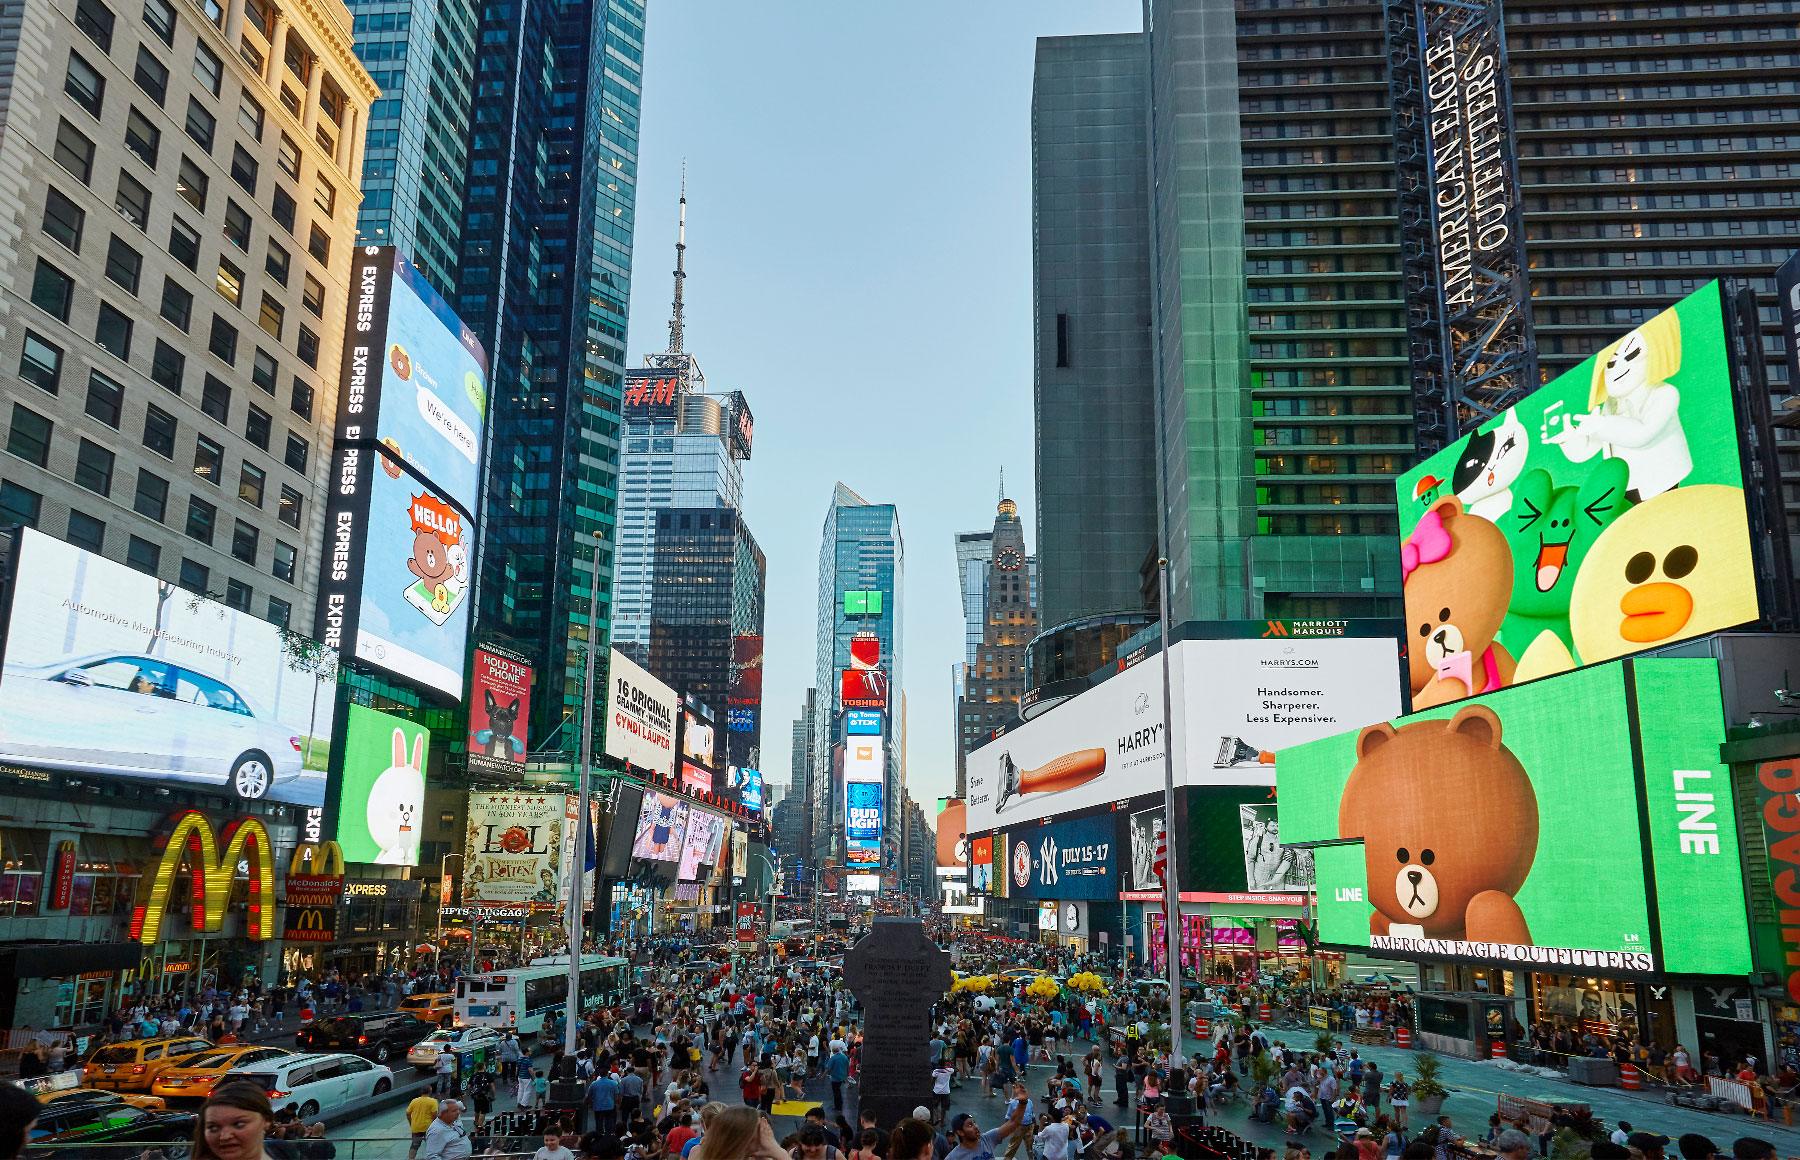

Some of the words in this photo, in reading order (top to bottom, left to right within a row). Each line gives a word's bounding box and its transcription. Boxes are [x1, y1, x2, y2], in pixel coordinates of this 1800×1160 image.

[1427, 34, 1460, 140] EAGLE
[1464, 54, 1508, 250] OUTFITTERS
[1434, 137, 1474, 307] AMERICAN
[356, 266, 377, 332] EXPRESS
[462, 329, 475, 349] LINE
[348, 346, 368, 414] EXPRESS
[414, 362, 438, 389] Brown
[624, 378, 677, 406] H&M
[426, 400, 452, 430] We're
[406, 452, 430, 477] Brown
[414, 504, 458, 538] HELLO!
[332, 512, 352, 581] EXPRESS
[62, 598, 129, 628] Automotive
[132, 618, 204, 654] Manufacturing
[206, 644, 242, 666] Industry
[483, 655, 509, 670] HOLD
[510, 664, 526, 677] THE
[489, 667, 520, 684] PHONE
[616, 695, 645, 718] GRAMMY
[617, 678, 629, 697] 16
[631, 687, 671, 723] ORIGINAL
[1257, 688, 1324, 697] Handsomer.
[1262, 701, 1320, 712] Sharperer.
[616, 713, 640, 736] CYNDI
[642, 730, 670, 751] LAUPER
[1247, 714, 1269, 723] Less
[1273, 714, 1336, 725] Expensiver.
[1118, 723, 1165, 755] HARRY'
[652, 770, 686, 793] 1540
[691, 786, 749, 819] BROADWAY
[848, 817, 880, 828] LIGHT
[850, 808, 878, 818] BUD
[1673, 770, 1720, 854] LINE
[1062, 847, 1080, 867] JULY
[1082, 844, 1109, 862] 15-17
[1335, 888, 1362, 902] LINE
[437, 907, 469, 916] GIFTS
[1624, 934, 1639, 942] LN
[1372, 936, 1449, 955] AMERICAN
[1454, 942, 1508, 959] EAGLE
[1514, 944, 1651, 972] OUTFITTERS
